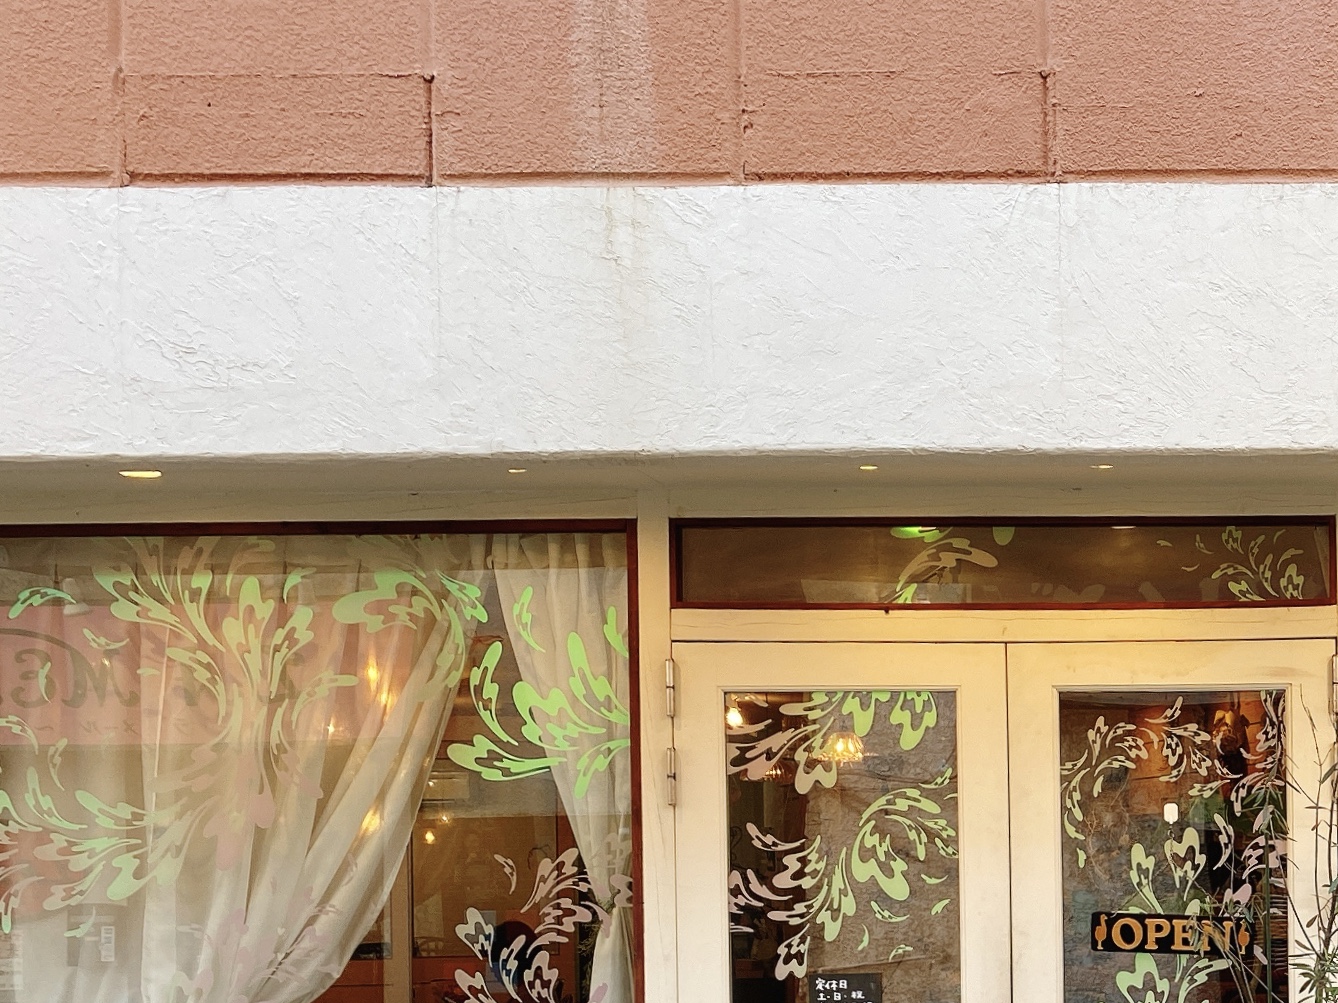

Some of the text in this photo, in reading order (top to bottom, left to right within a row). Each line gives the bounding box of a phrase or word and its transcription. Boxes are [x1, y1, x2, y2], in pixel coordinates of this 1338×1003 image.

[1111, 917, 1233, 952] OPEN
[816, 977, 848, 990] 定休日
